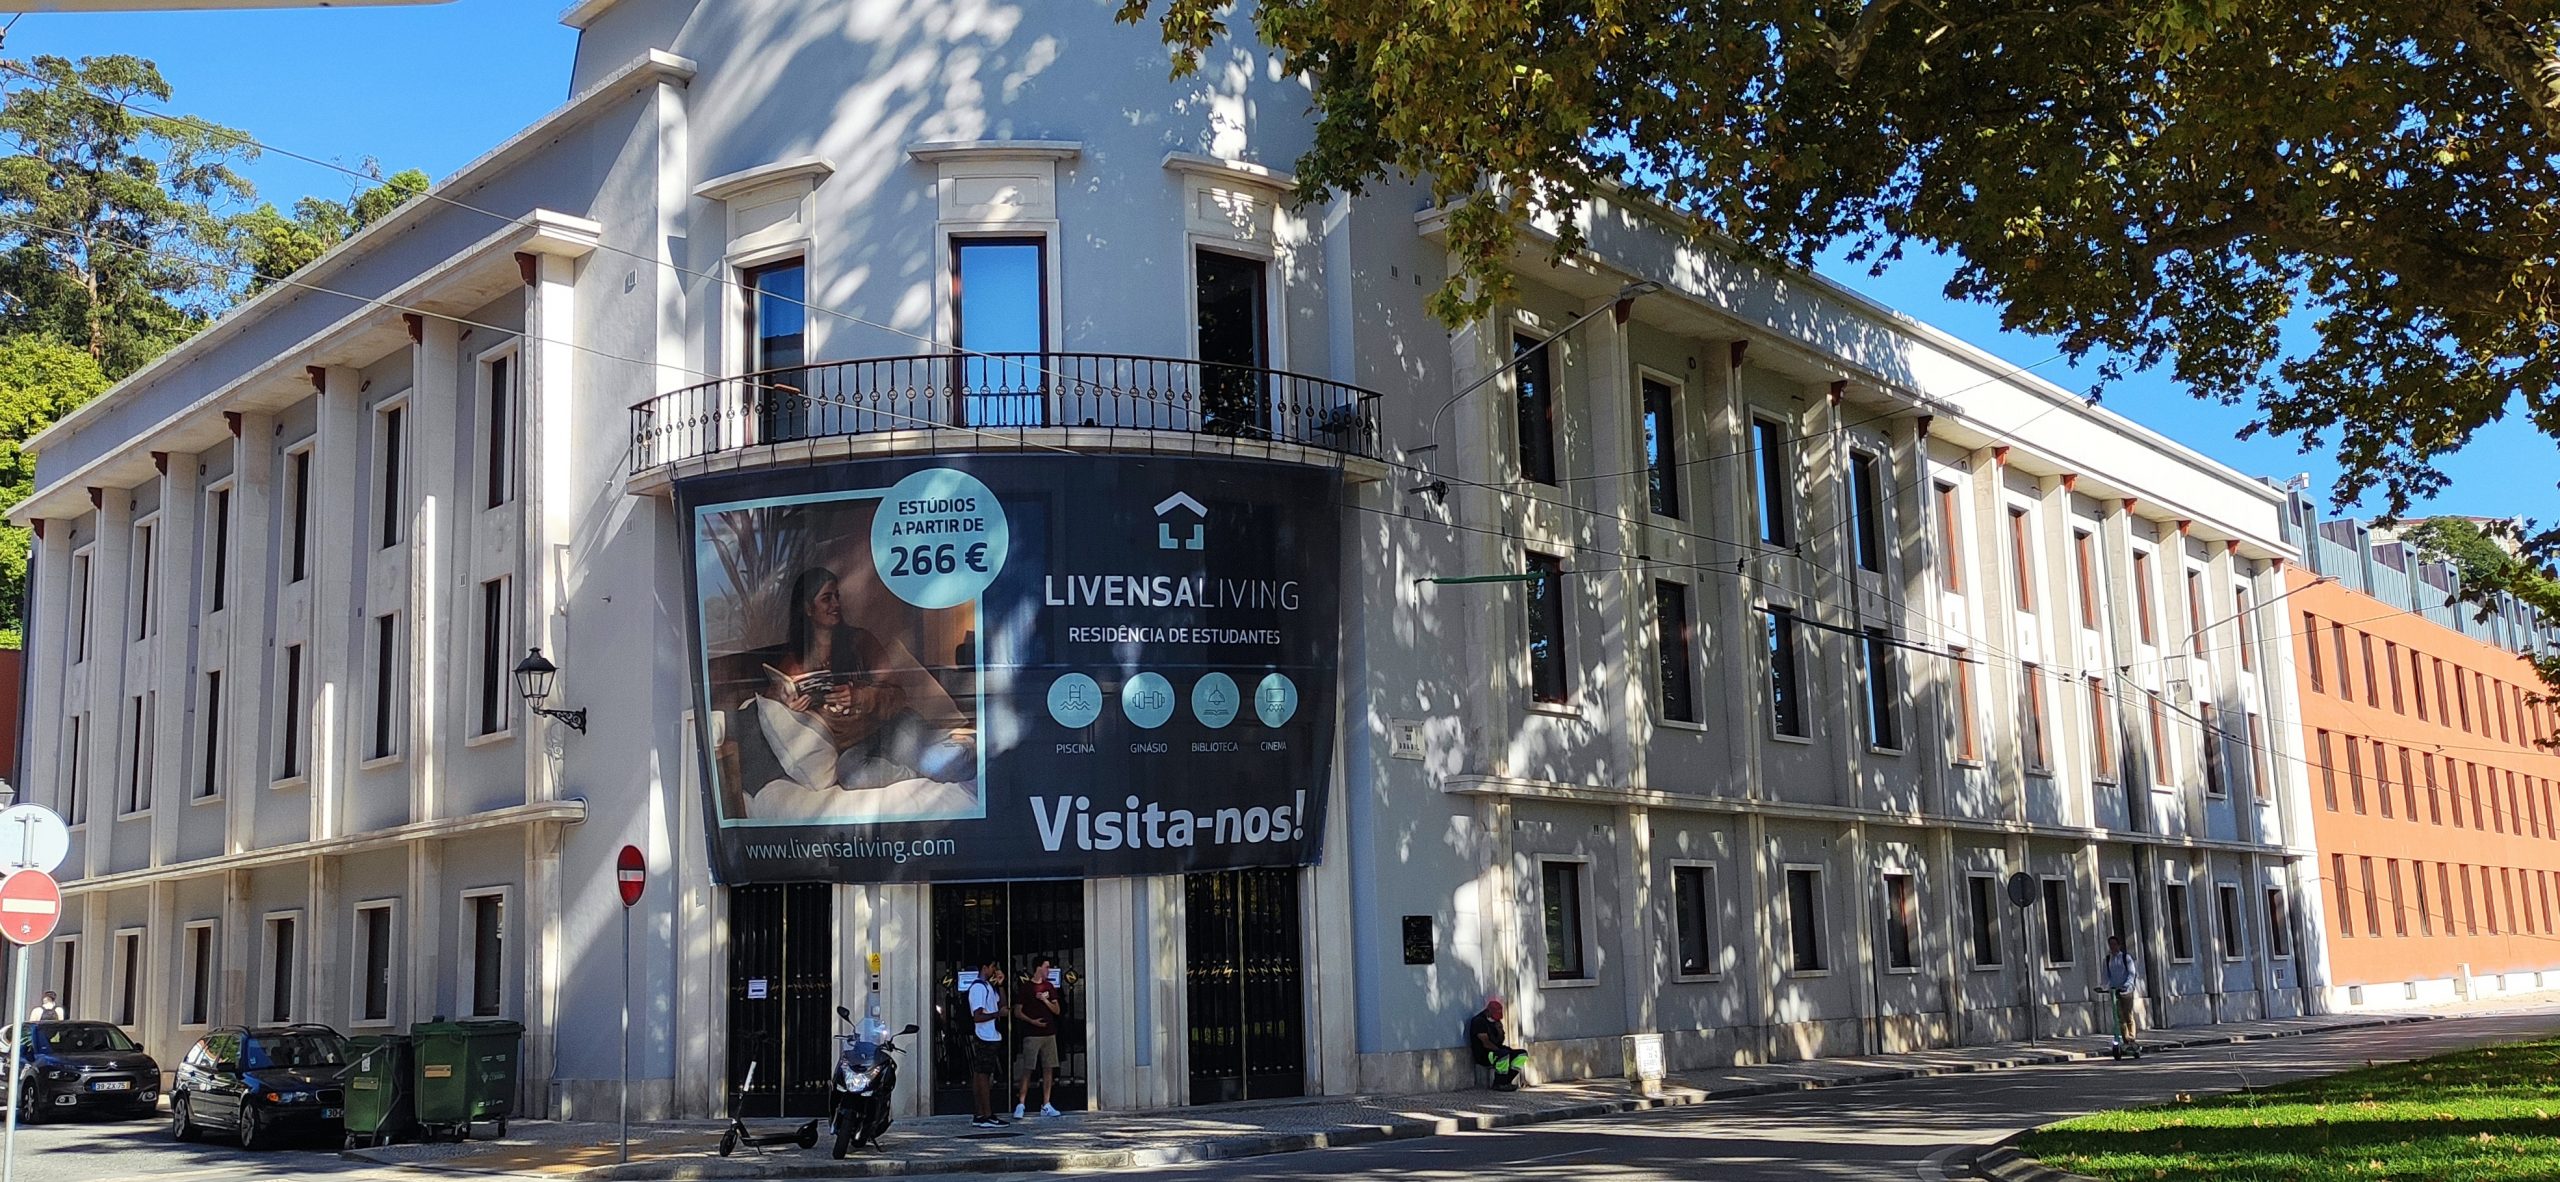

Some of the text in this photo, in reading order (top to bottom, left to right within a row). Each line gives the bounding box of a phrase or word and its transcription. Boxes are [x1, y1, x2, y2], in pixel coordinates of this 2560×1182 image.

[898, 497, 976, 516] ESTÚDIOS
[892, 518, 984, 536] A PARTIR DE
[890, 542, 988, 577] 266 €
[1069, 624, 1280, 645] RESIDÊNCIA DE ESTUDANTES
[1056, 743, 1096, 754] PISCINA
[1130, 741, 1168, 754] GINÁSIO
[1191, 741, 1239, 752] BIBLIOTECA
[1260, 741, 1287, 752] CINEMA
[1029, 789, 1306, 852] Visita-nos!
[745, 836, 956, 864] www.livensaliving.com
